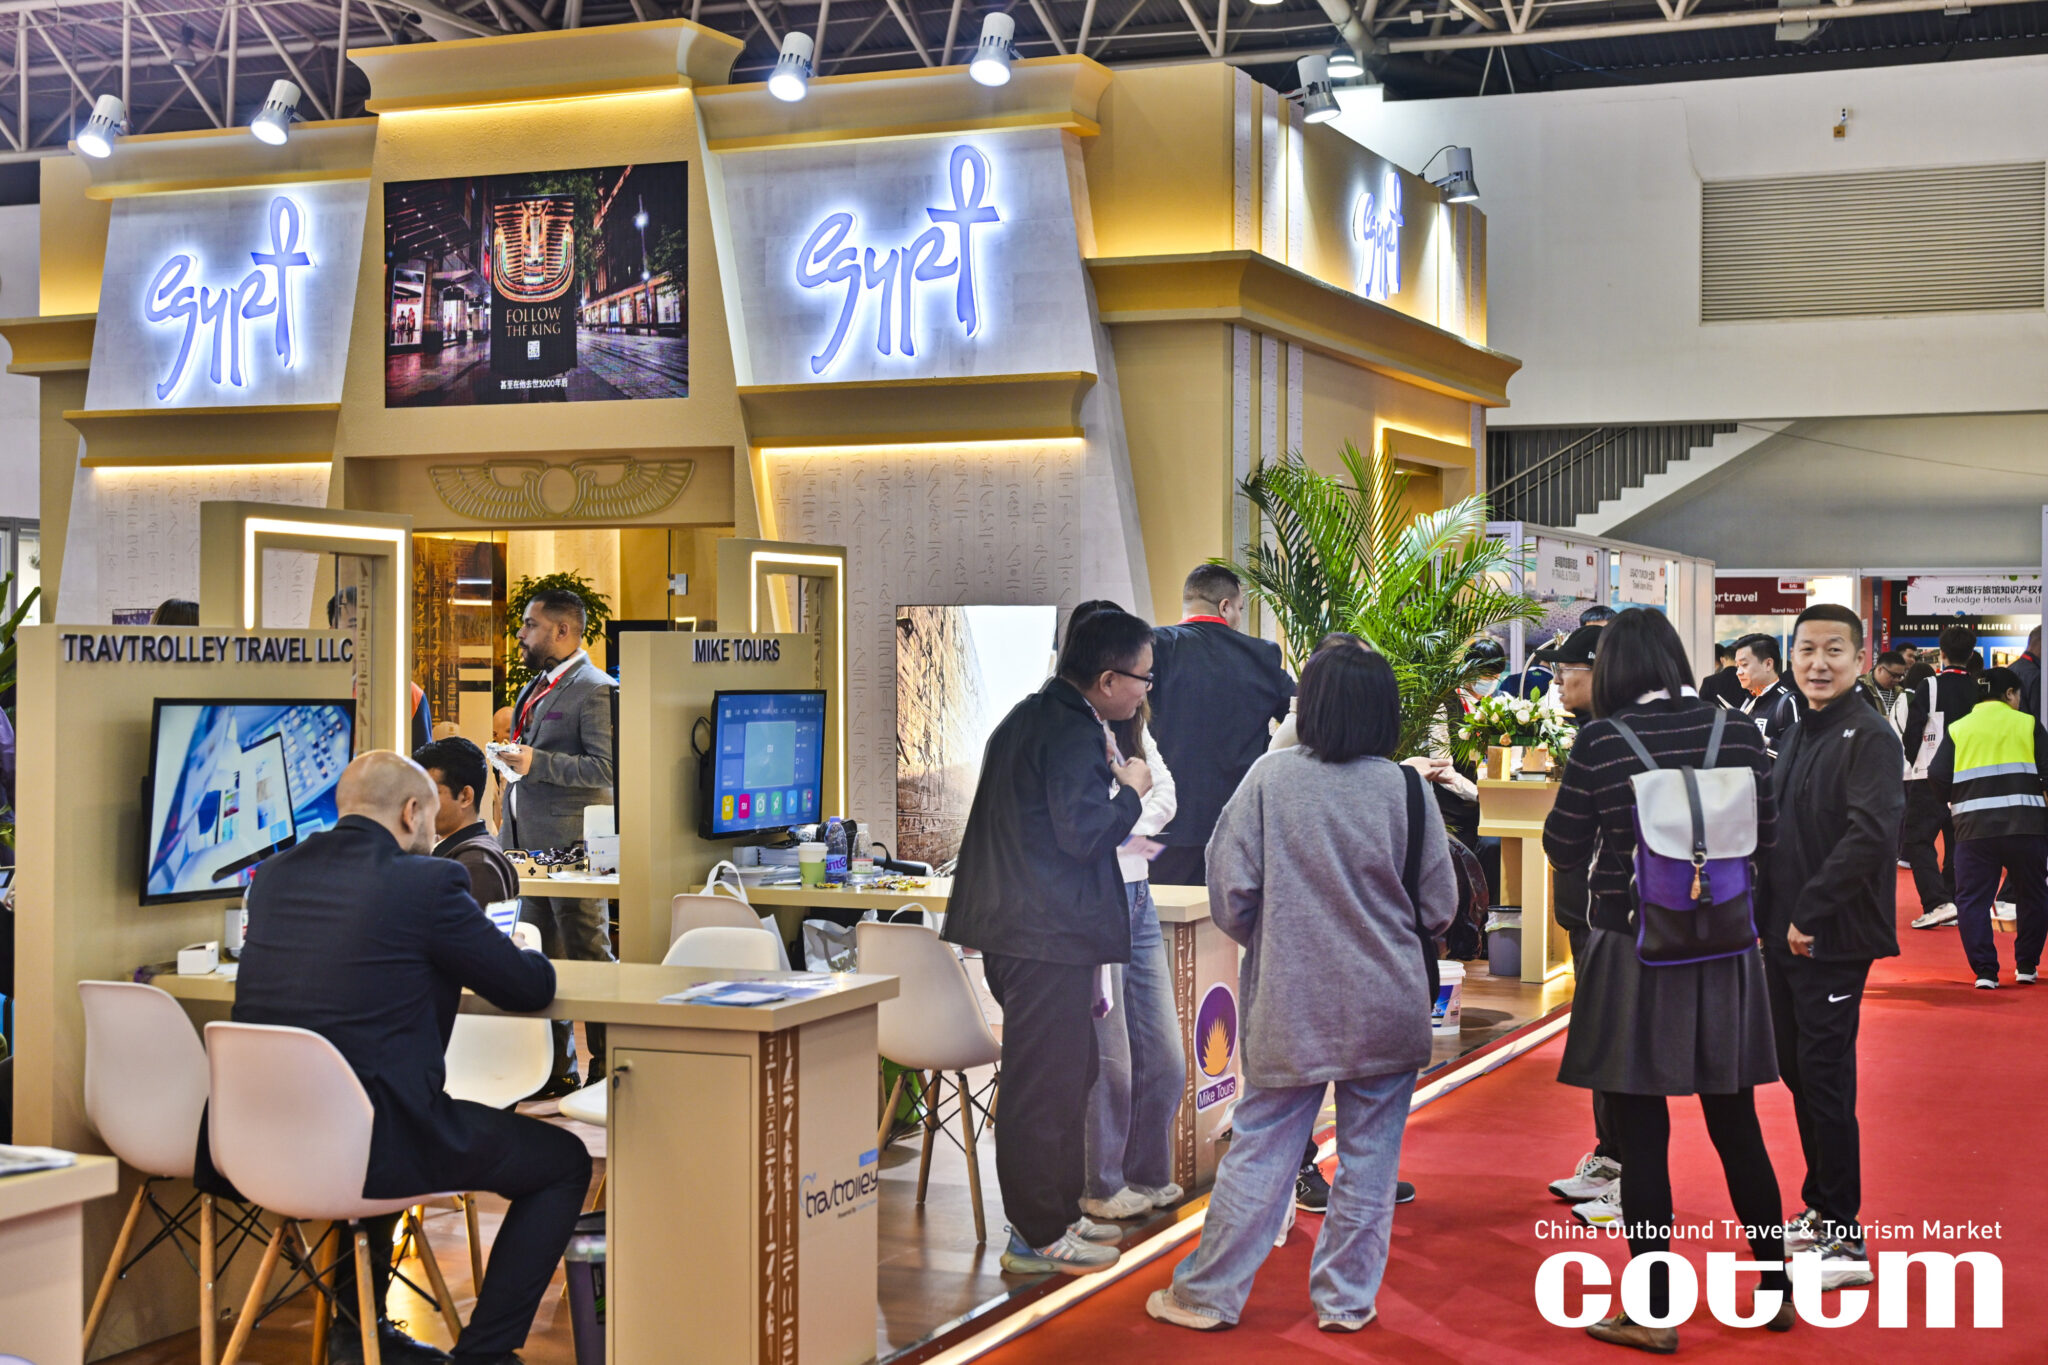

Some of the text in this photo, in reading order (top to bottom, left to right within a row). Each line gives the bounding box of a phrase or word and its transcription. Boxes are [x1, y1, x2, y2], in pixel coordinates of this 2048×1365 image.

[506, 307, 562, 323] FOLLOW
[505, 323, 561, 336] THE KING
[500, 377, 568, 390] 甚至在他去世3000年后
[1933, 595, 1980, 605] Travelodge
[1983, 595, 2011, 604] Hotels
[2014, 595, 2033, 604] Asia
[60, 634, 354, 663] TRAVTROLLEY TRAVEL LLC
[692, 638, 780, 663] MIKE TOURS
[1199, 1081, 1235, 1108] Mike Tours
